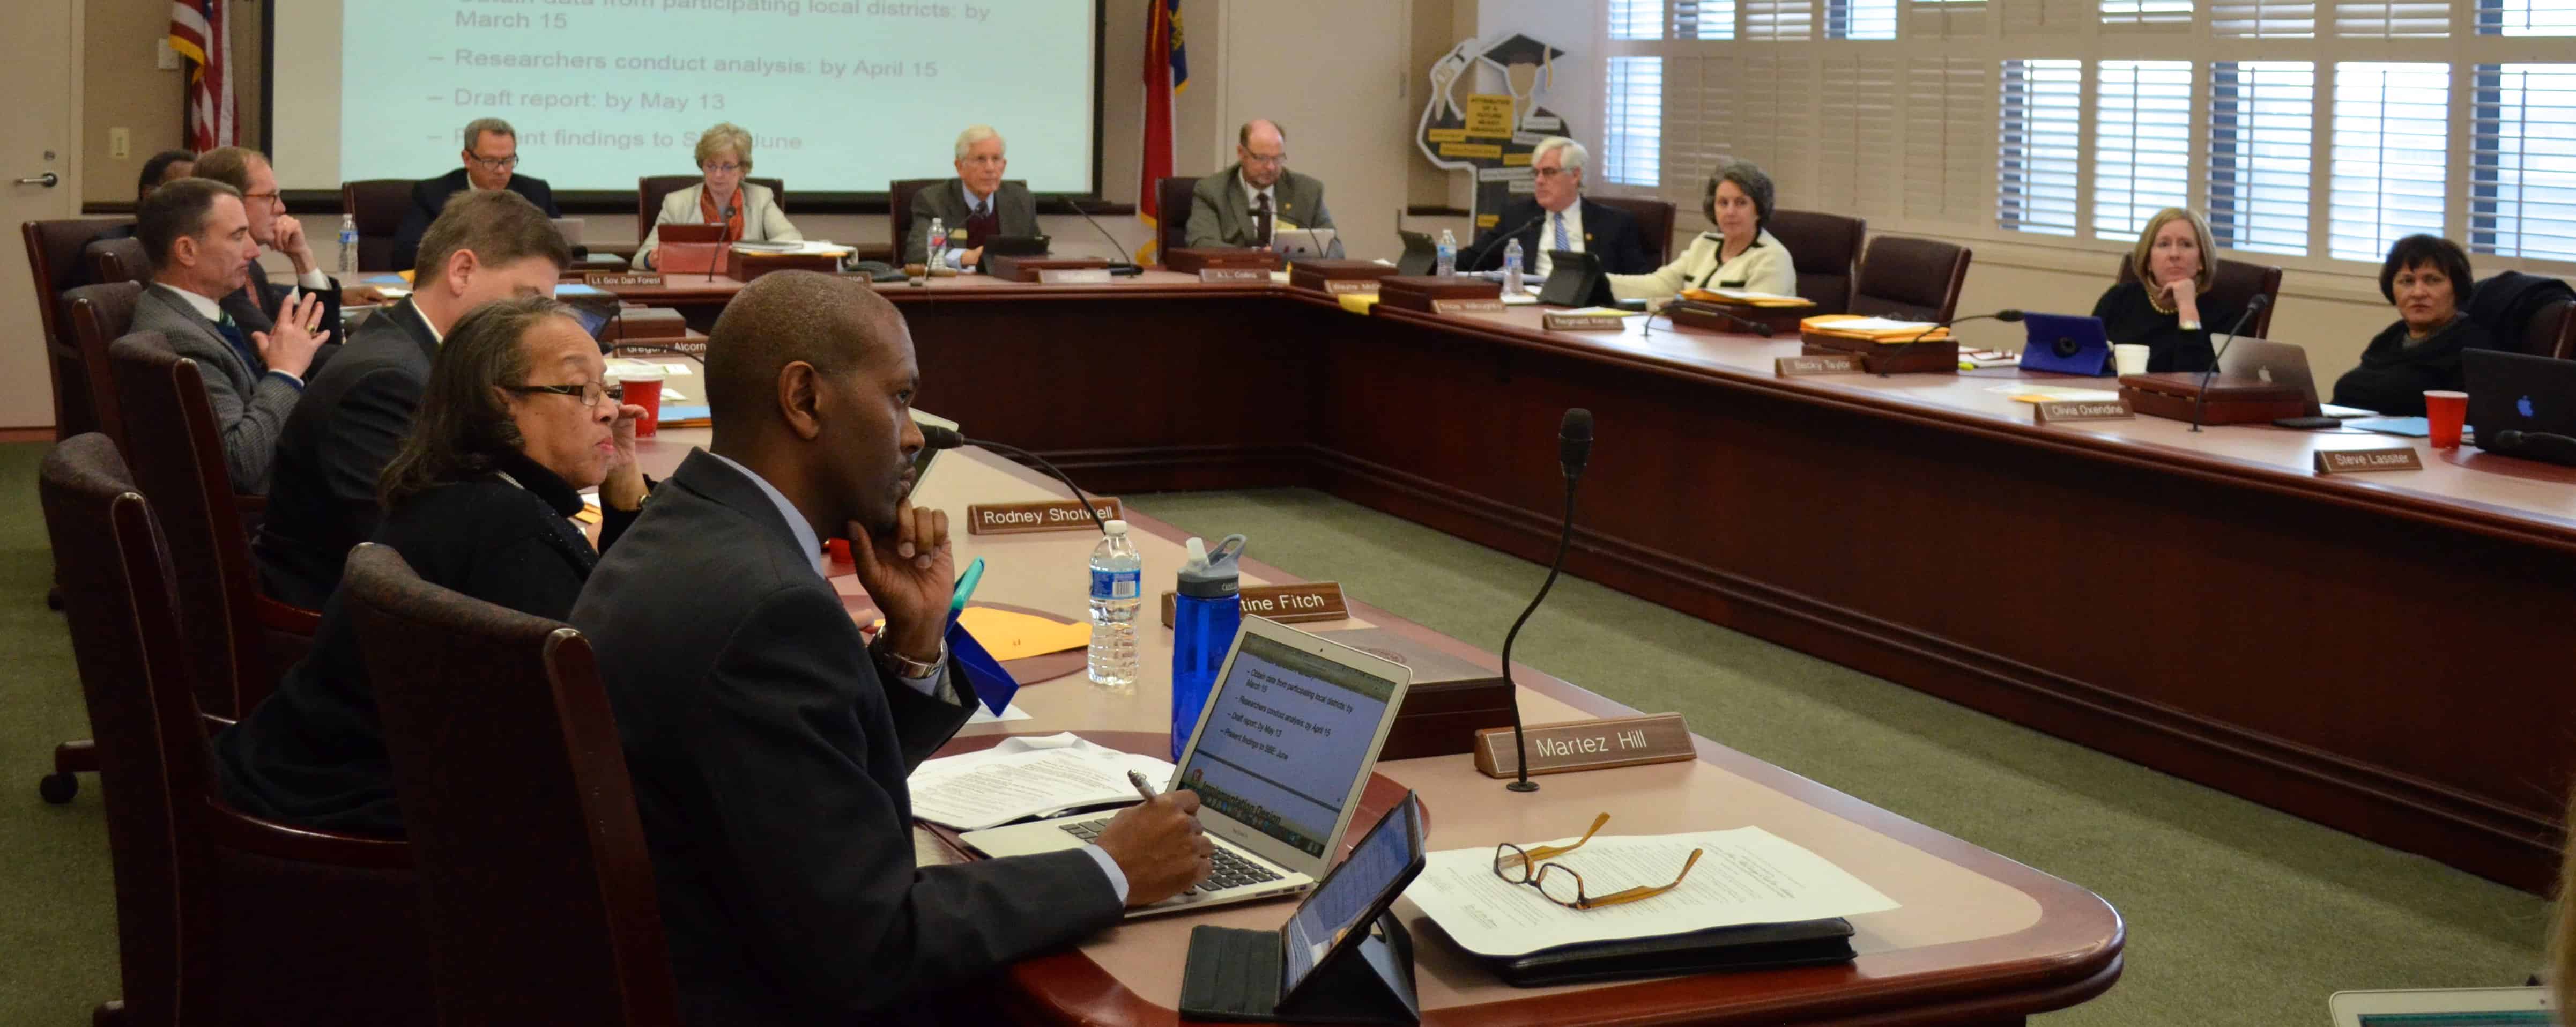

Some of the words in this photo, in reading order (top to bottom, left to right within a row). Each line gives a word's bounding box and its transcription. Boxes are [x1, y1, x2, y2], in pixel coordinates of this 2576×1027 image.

[808, 0, 860, 15] local
[866, 1, 957, 19] districts:
[965, 4, 991, 21] by
[455, 10, 530, 29] March
[540, 12, 568, 29] 15
[455, 48, 607, 69] Researchers
[614, 54, 706, 71] conduct
[713, 56, 811, 77] analysis:
[820, 60, 846, 78] by
[853, 60, 903, 78] April
[912, 61, 938, 78] 15
[454, 88, 512, 107] Draft
[520, 93, 596, 110] report:
[605, 92, 632, 112] by
[641, 92, 689, 113] May
[700, 93, 725, 110] 13
[555, 128, 645, 150] findings
[653, 131, 674, 147] to
[752, 132, 803, 150] June
[674, 342, 707, 351] Alcorn
[1794, 360, 1822, 372] Becky
[1824, 359, 1851, 371] Taylor
[2052, 404, 2078, 417] Olivia
[2080, 403, 2124, 416] Oxendine
[2335, 453, 2368, 466] Steve
[2371, 452, 2410, 465] Lassiter
[984, 511, 1042, 524] Rodney
[1278, 593, 1325, 609] Fitch
[1535, 735, 1609, 759] Martez
[1617, 729, 1647, 751] Hill
